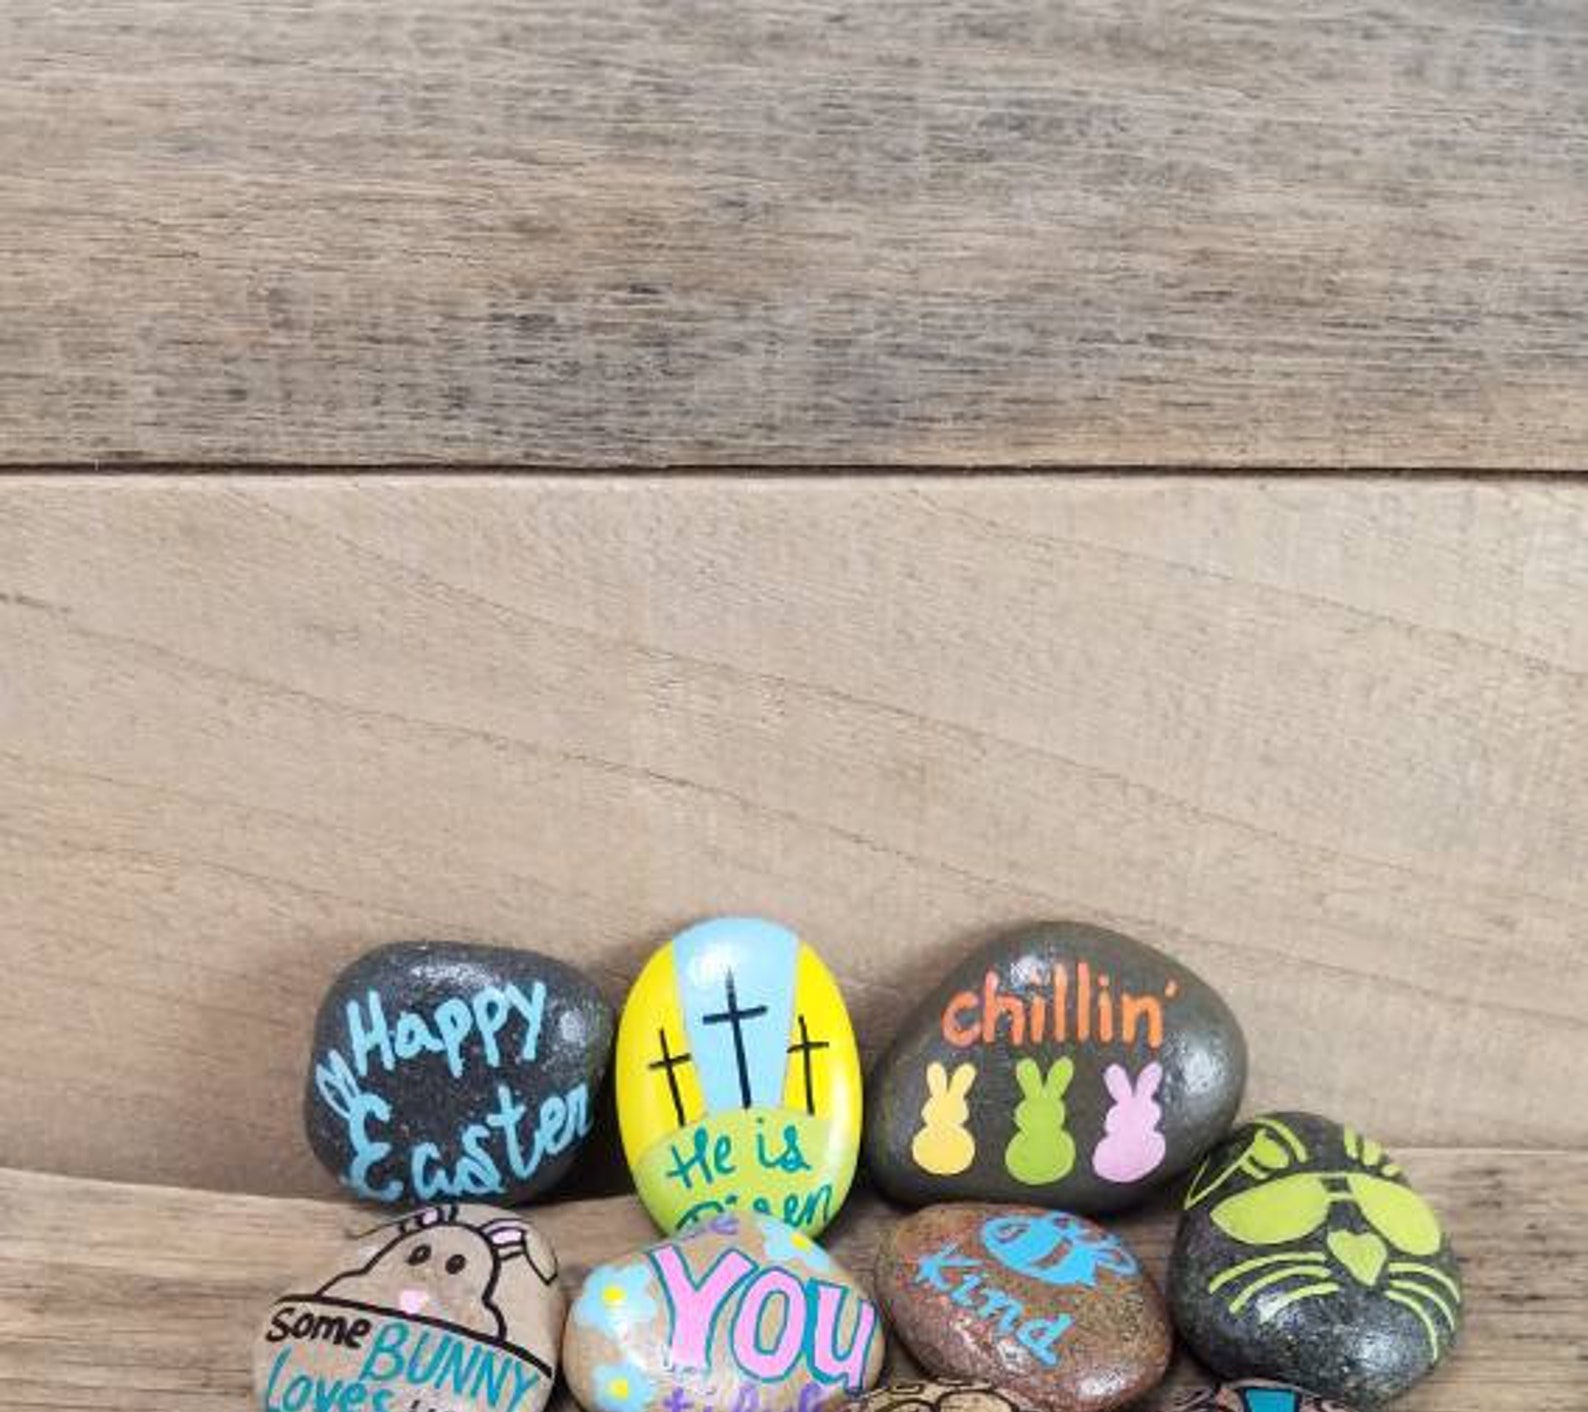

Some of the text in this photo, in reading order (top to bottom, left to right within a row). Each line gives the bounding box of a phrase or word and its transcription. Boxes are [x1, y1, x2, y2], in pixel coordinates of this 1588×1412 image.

[347, 981, 547, 1079] Happy
[942, 963, 1178, 1049] chillin'
[667, 1117, 812, 1188] He is
[649, 1243, 879, 1397] YOU
